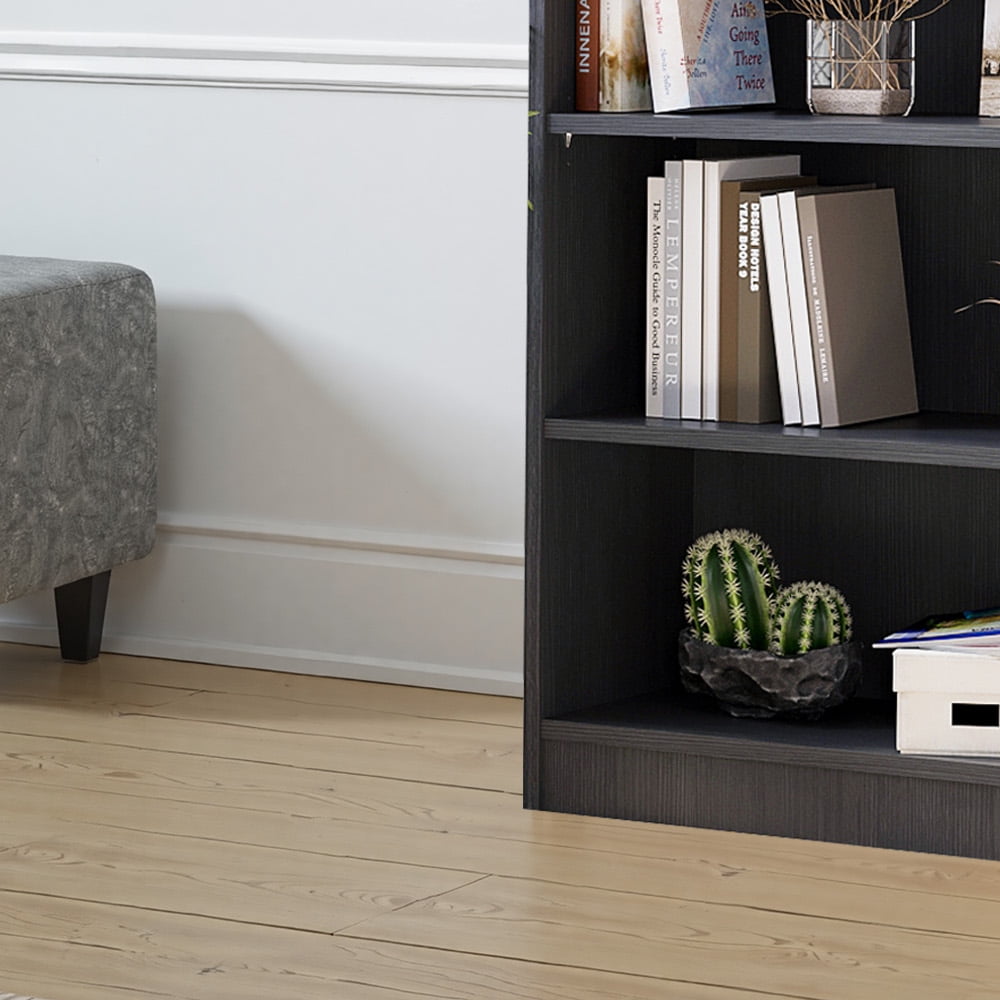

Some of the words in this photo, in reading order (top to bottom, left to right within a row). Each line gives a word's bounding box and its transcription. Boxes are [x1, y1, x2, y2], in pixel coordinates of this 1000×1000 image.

[729, 27, 760, 45] Going
[733, 51, 763, 66] There
[736, 76, 765, 90] Twice
[652, 200, 662, 221] The
[738, 202, 749, 232] YEAR
[750, 202, 760, 246] DESIGN
[652, 224, 661, 270] Monocle
[738, 235, 749, 268] BOOK
[750, 248, 760, 292] HOTELS
[652, 272, 661, 304] Guide
[665, 217, 680, 386] LEMPEREUR
[652, 307, 660, 317] to
[652, 320, 661, 349] Good
[652, 352, 660, 396] Business
